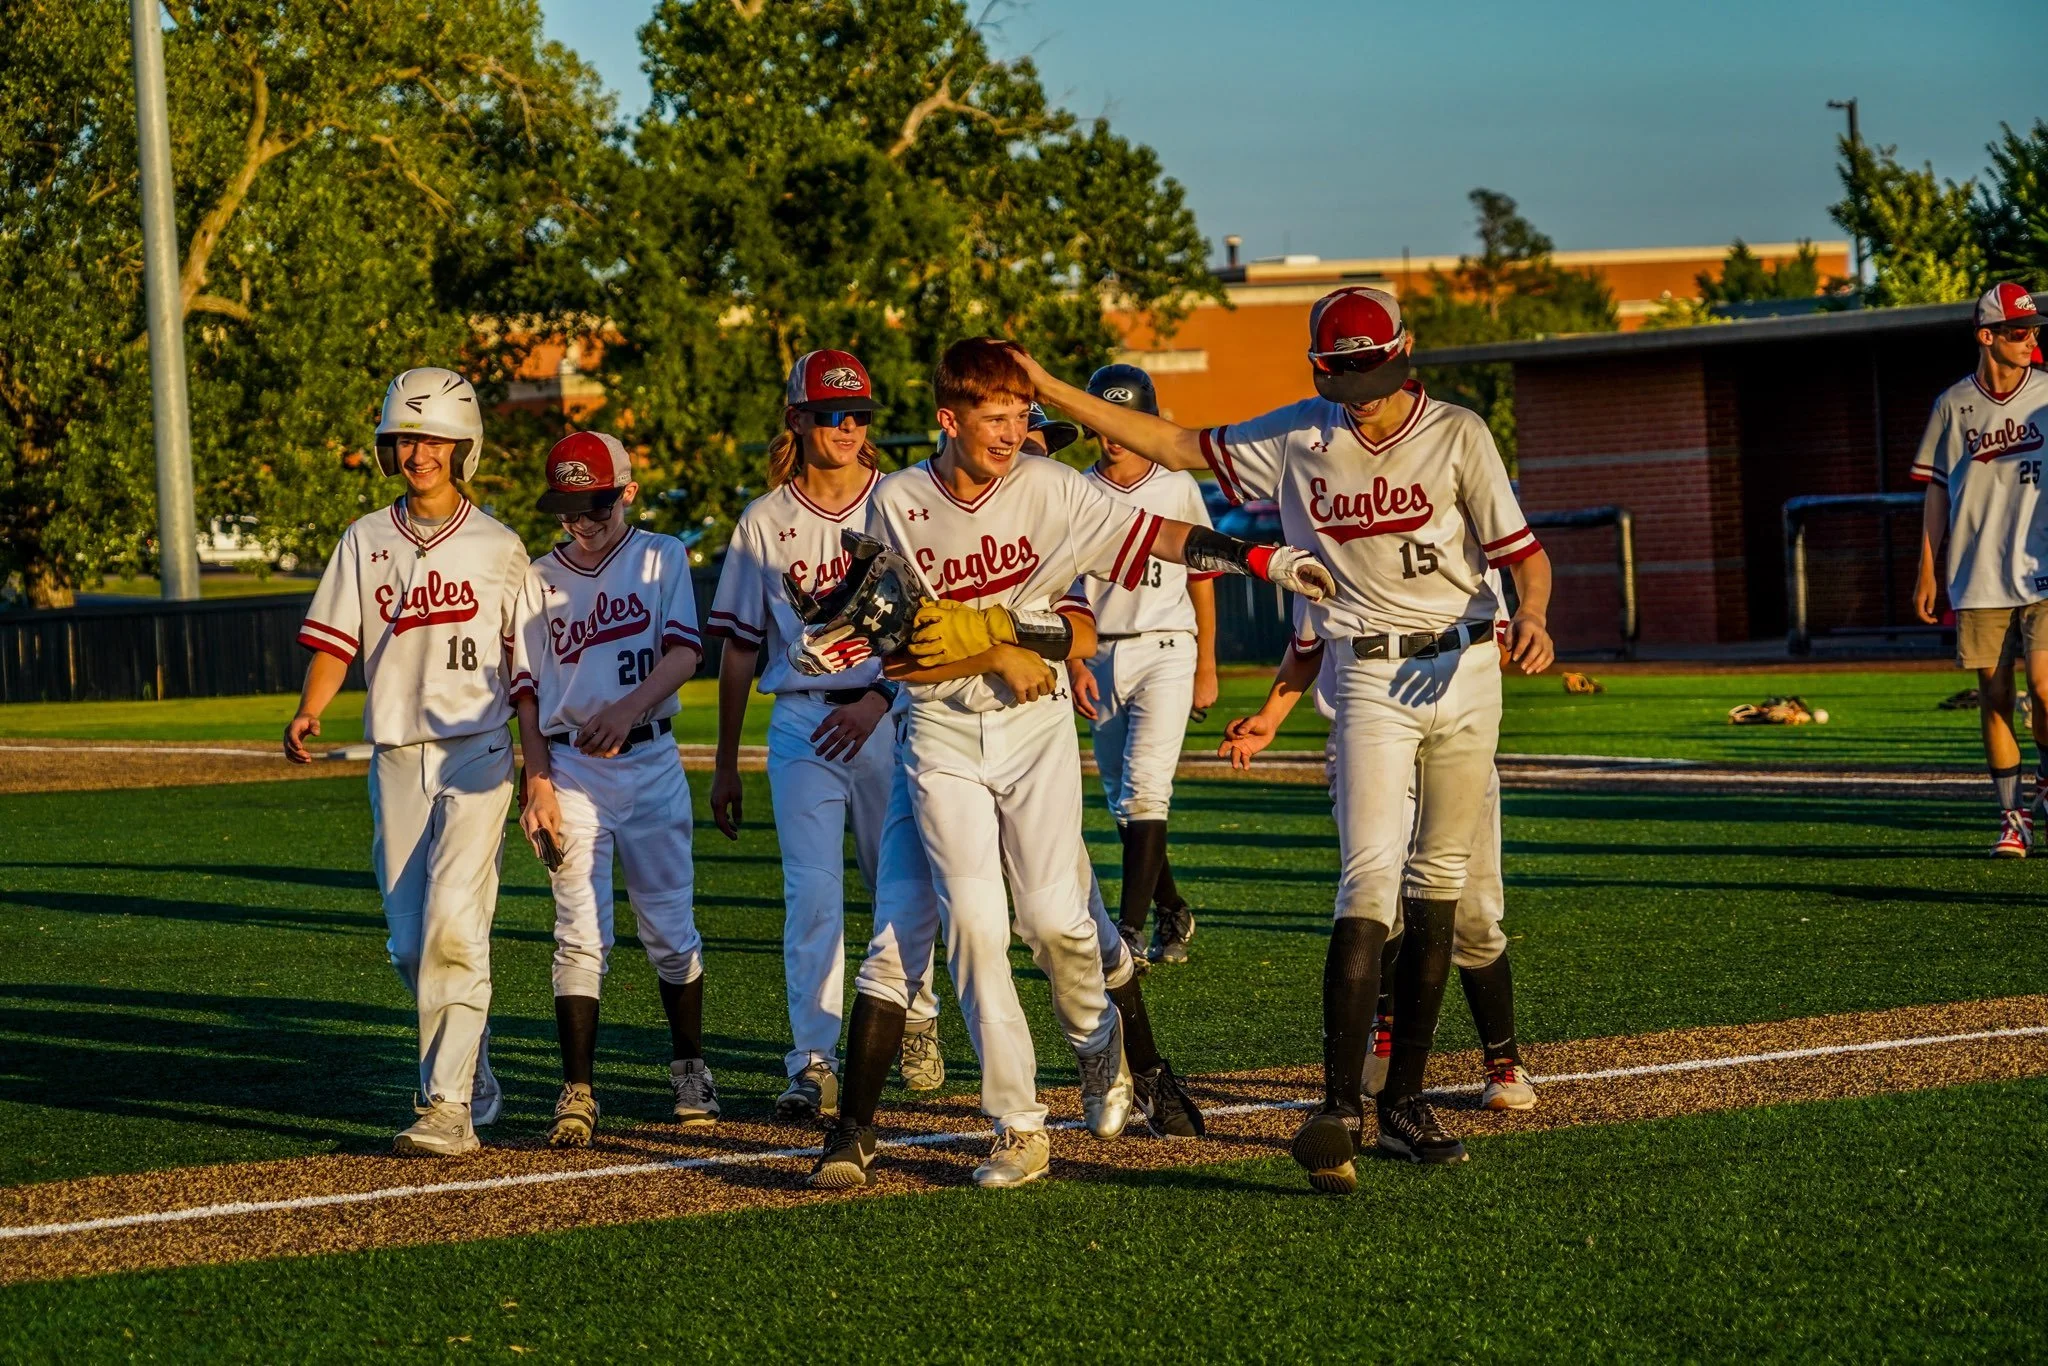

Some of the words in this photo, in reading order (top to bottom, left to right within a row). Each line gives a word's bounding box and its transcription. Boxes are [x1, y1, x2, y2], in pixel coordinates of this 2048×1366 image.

[1966, 418, 2044, 459] Eagles
[2019, 460, 2042, 484] 25
[1310, 476, 1433, 538] Eagles
[916, 535, 1039, 597] Eagles
[1140, 559, 1162, 588] 13
[1399, 541, 1439, 579] 15
[551, 592, 651, 661] Eagles
[446, 635, 478, 671] 18
[617, 648, 654, 685] 20
